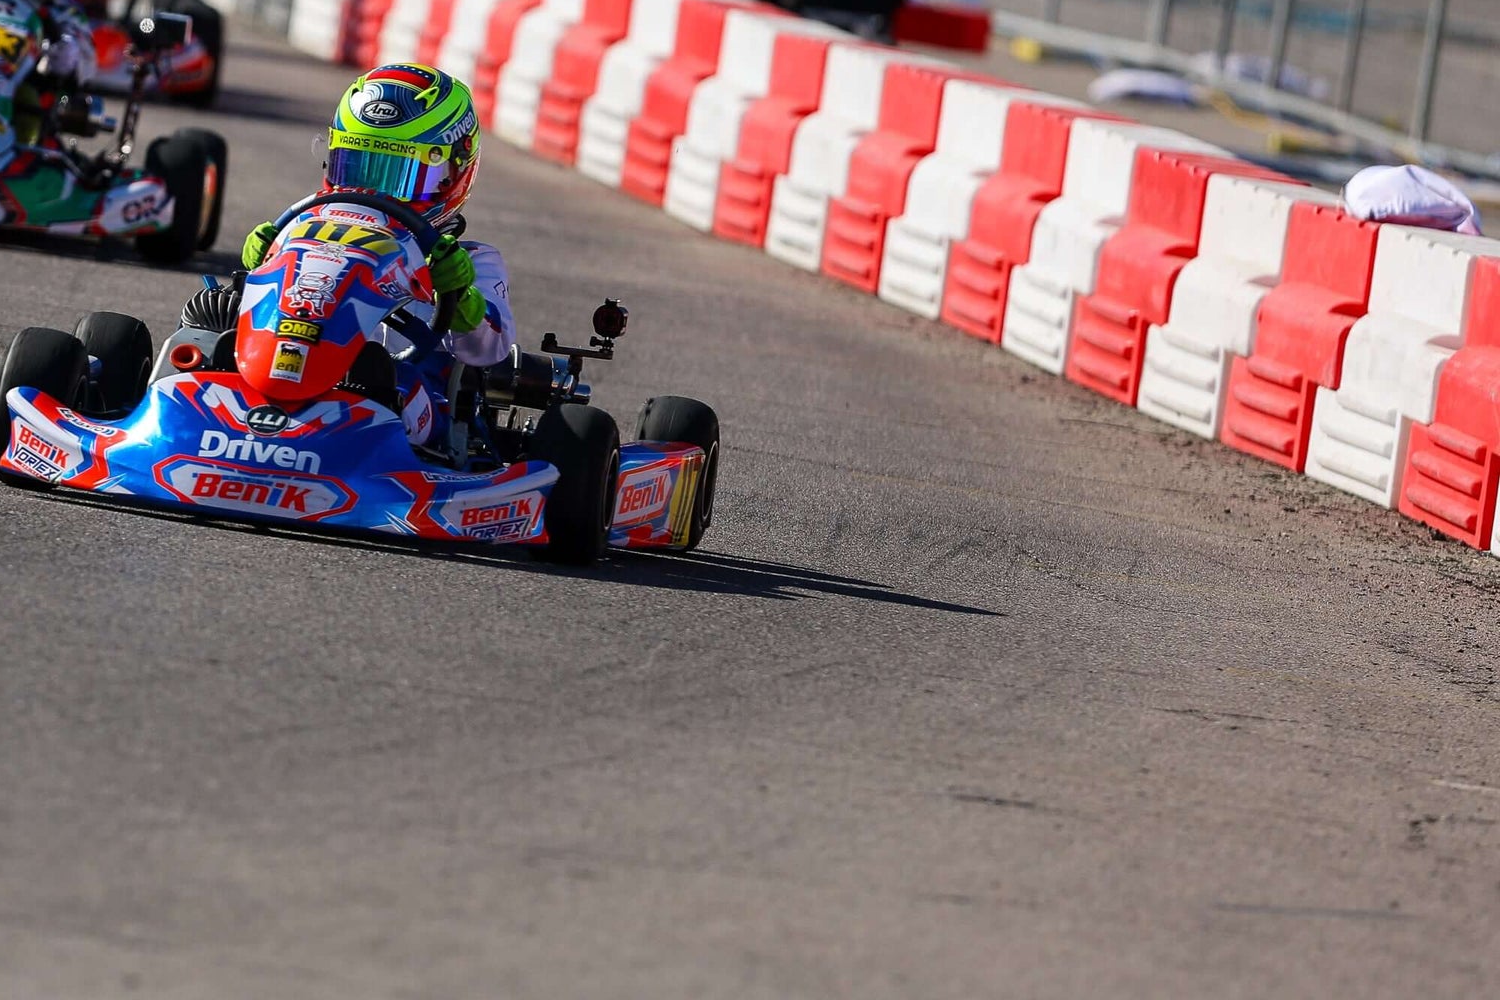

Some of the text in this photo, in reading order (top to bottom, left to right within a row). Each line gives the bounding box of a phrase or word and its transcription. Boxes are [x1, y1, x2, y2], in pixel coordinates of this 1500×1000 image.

[369, 103, 398, 117] Arai
[443, 112, 475, 145] Driven
[373, 139, 416, 155] RACING
[304, 221, 392, 251] 117
[279, 321, 318, 338] OMP
[276, 360, 301, 373] eni
[198, 430, 321, 476] Driven
